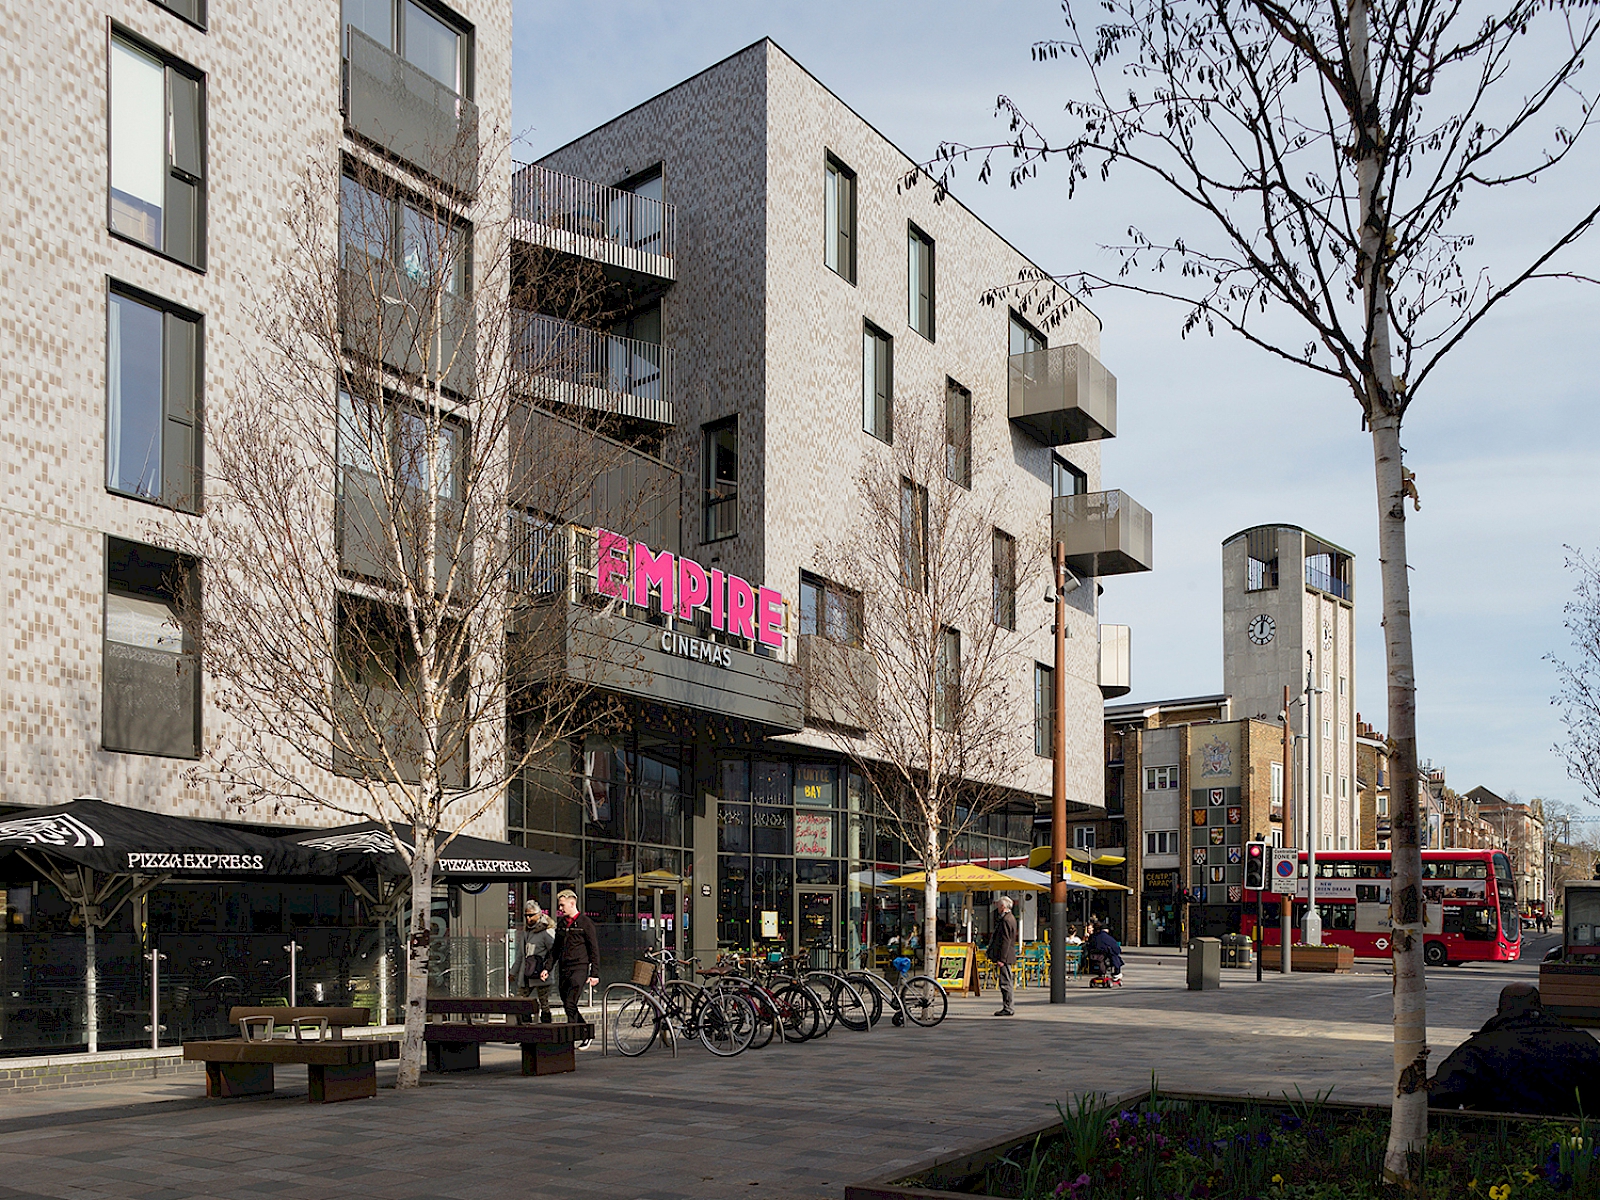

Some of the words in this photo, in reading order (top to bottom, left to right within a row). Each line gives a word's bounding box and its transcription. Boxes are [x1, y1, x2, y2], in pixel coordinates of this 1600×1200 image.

[597, 527, 783, 648] EMPIRE
[661, 631, 732, 668] CINEMAS
[797, 768, 830, 782] TURTLE
[804, 785, 821, 799] BAY
[127, 853, 263, 869] PIZZAEXPRESS
[439, 859, 532, 872] PIZZAEXPRESS
